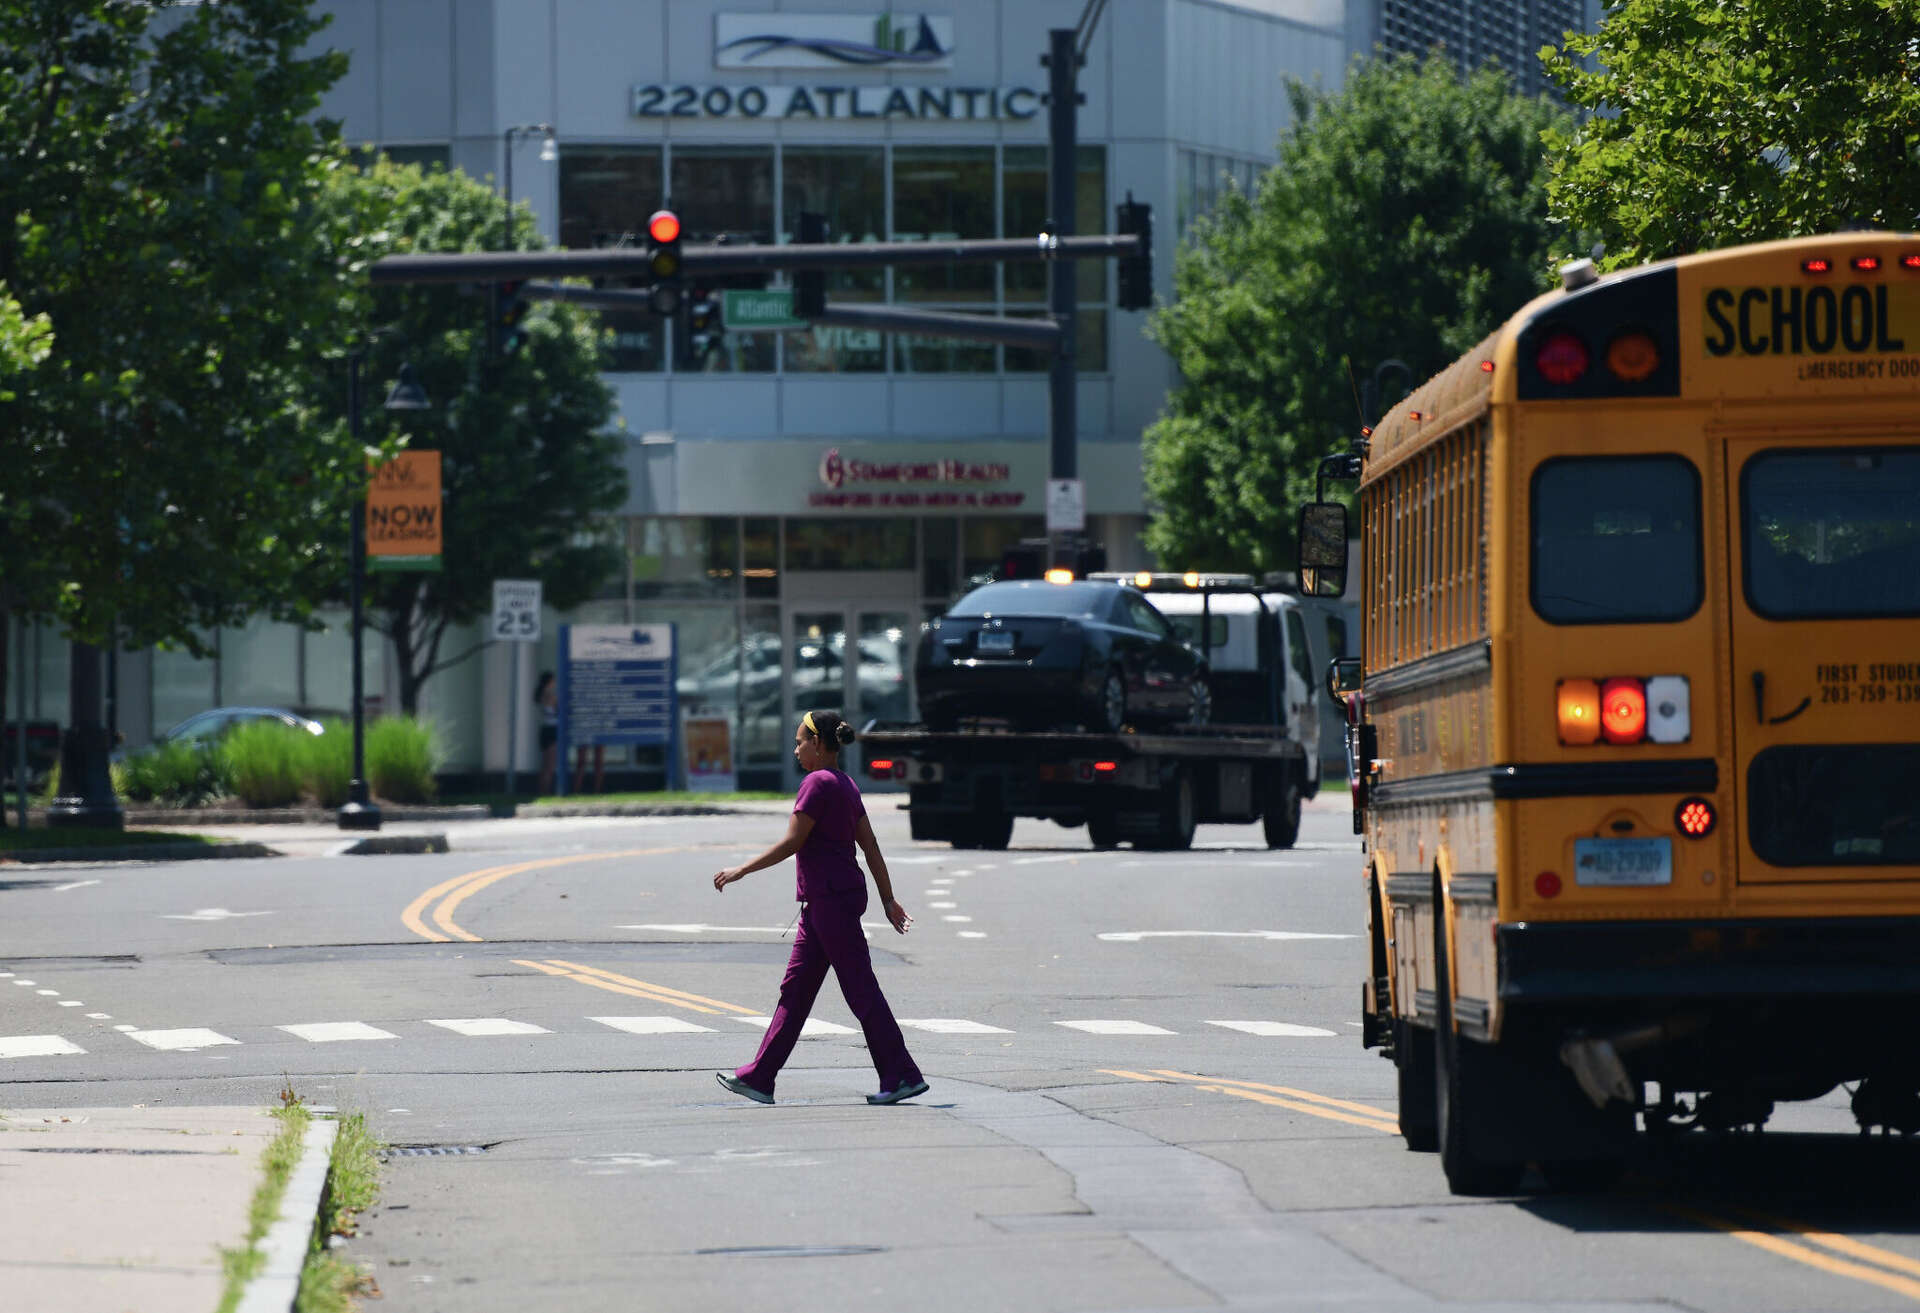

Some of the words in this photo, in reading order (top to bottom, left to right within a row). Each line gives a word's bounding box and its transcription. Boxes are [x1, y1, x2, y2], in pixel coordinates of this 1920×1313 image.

[638, 85, 767, 118] 2200
[785, 86, 1041, 119] ATLANTIC
[1705, 284, 1904, 357] SCHOOL
[372, 504, 437, 527] NOW
[372, 529, 437, 541] LEASING
[498, 611, 538, 636] 25
[1817, 663, 1857, 682] FIRST
